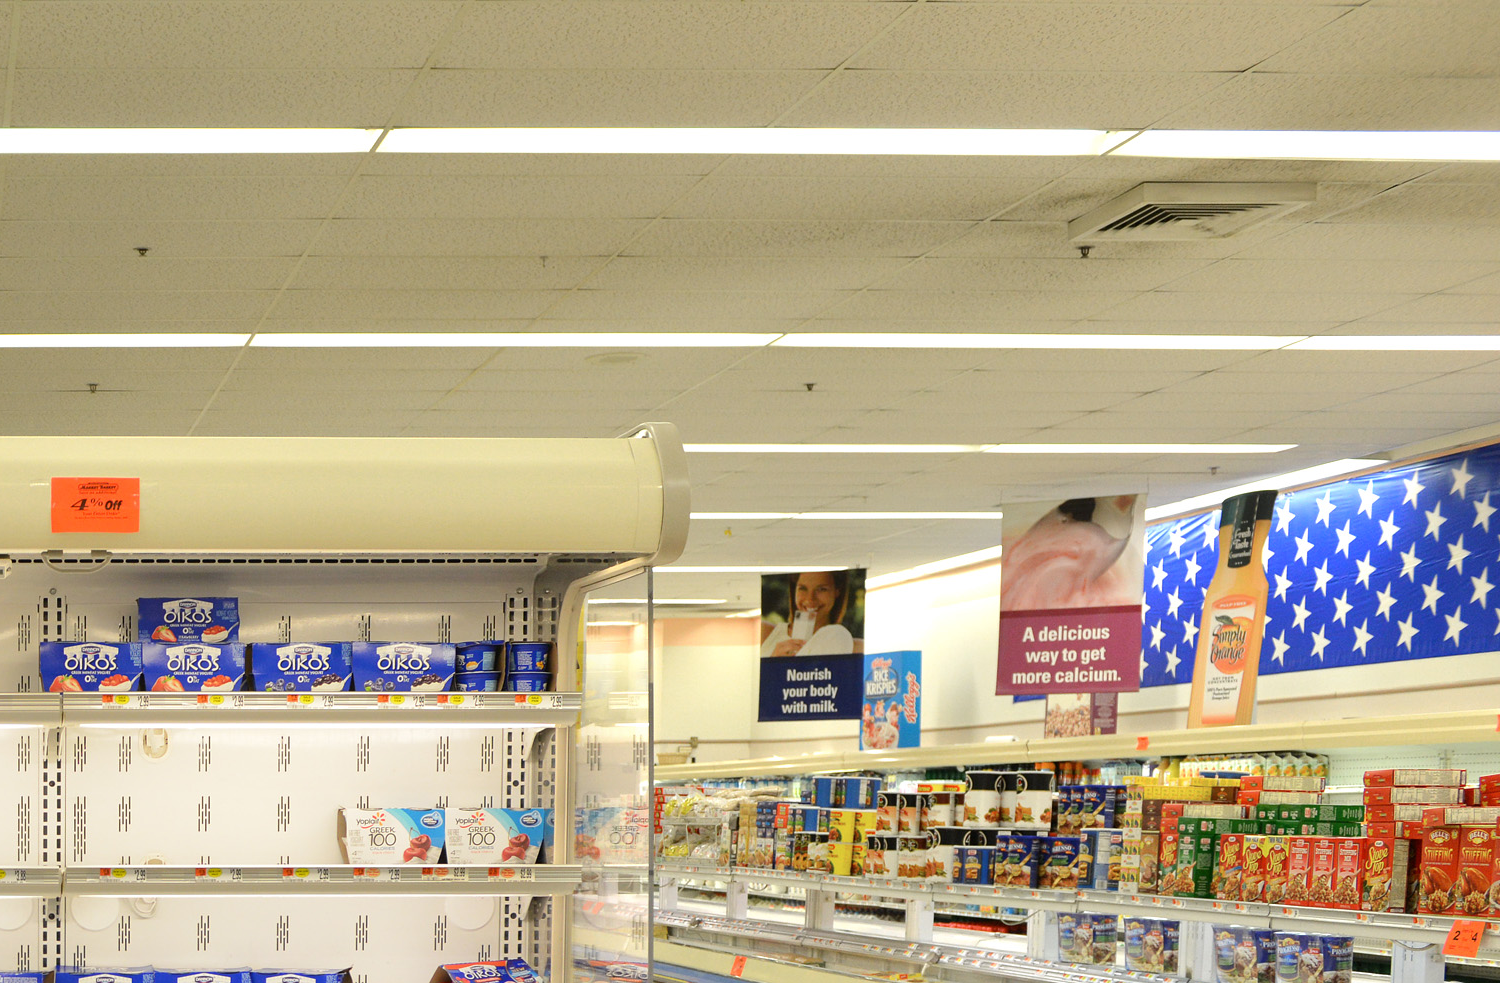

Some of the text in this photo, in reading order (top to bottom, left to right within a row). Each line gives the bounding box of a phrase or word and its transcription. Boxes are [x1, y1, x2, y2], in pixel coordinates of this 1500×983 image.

[105, 500, 123, 511] Off
[1235, 528, 1251, 540] Fresh
[1232, 539, 1249, 549] Taste
[164, 611, 212, 624] OIKOS
[1022, 625, 1110, 642] A delicious
[1212, 624, 1247, 647] Simply
[1025, 646, 1106, 666] way to get
[1210, 644, 1245, 665] Orange
[64, 657, 117, 671] OIKOS
[167, 658, 220, 671] OIKOS
[278, 657, 330, 671] OIKOS
[377, 657, 431, 671] OIKOS
[786, 667, 832, 681] Nourish
[874, 670, 889, 681] RICE
[1012, 666, 1122, 684] more calcium.
[782, 683, 838, 700] your body
[866, 681, 897, 695] KRISPIES
[781, 700, 838, 714] with milk.
[368, 833, 397, 847] 100
[467, 832, 496, 846] 100
[1453, 930, 1478, 942] 2 4
[464, 968, 501, 980] OIKOS
